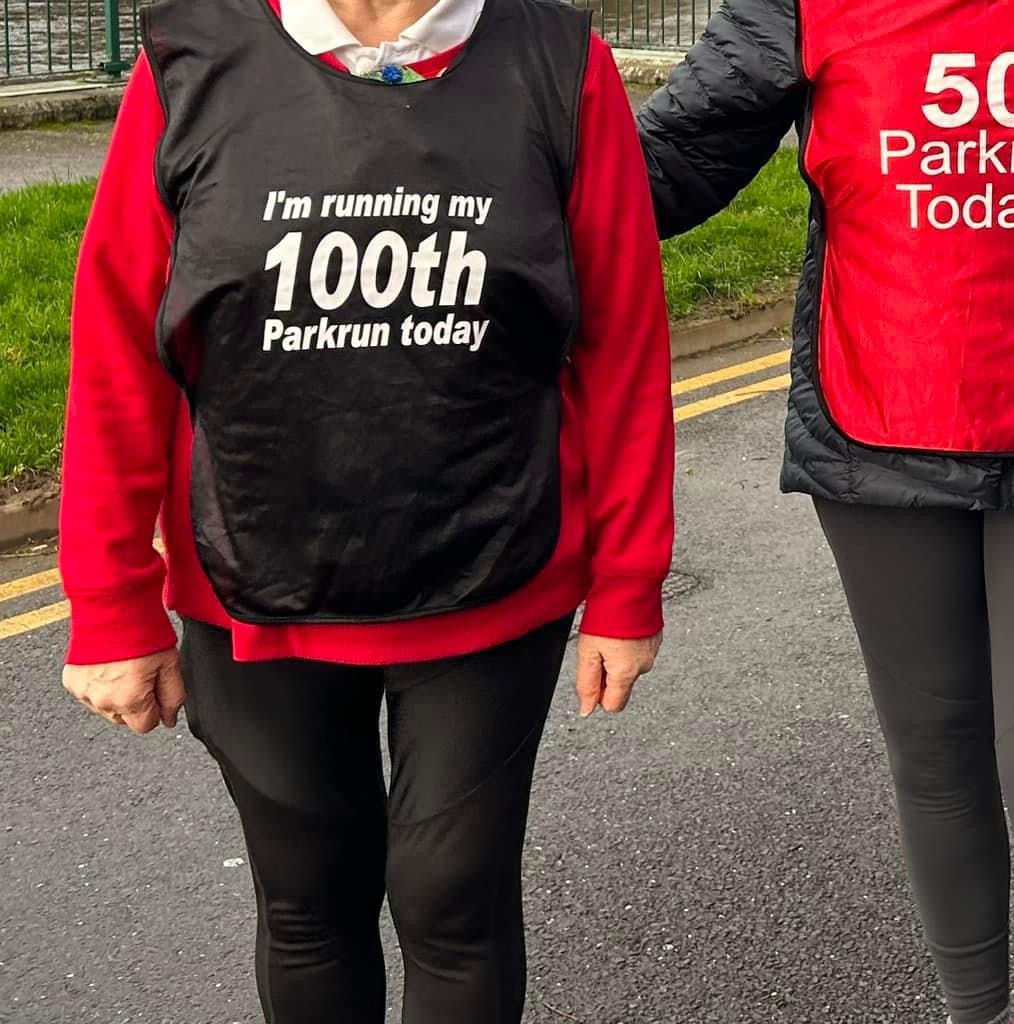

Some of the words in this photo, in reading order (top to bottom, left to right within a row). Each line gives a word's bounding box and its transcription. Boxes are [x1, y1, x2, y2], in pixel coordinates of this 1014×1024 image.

[262, 190, 313, 221] I'm
[319, 186, 441, 225] running
[447, 195, 493, 225] my
[264, 230, 487, 312] 100th
[262, 316, 391, 352] Parkrun
[400, 312, 490, 352] today
